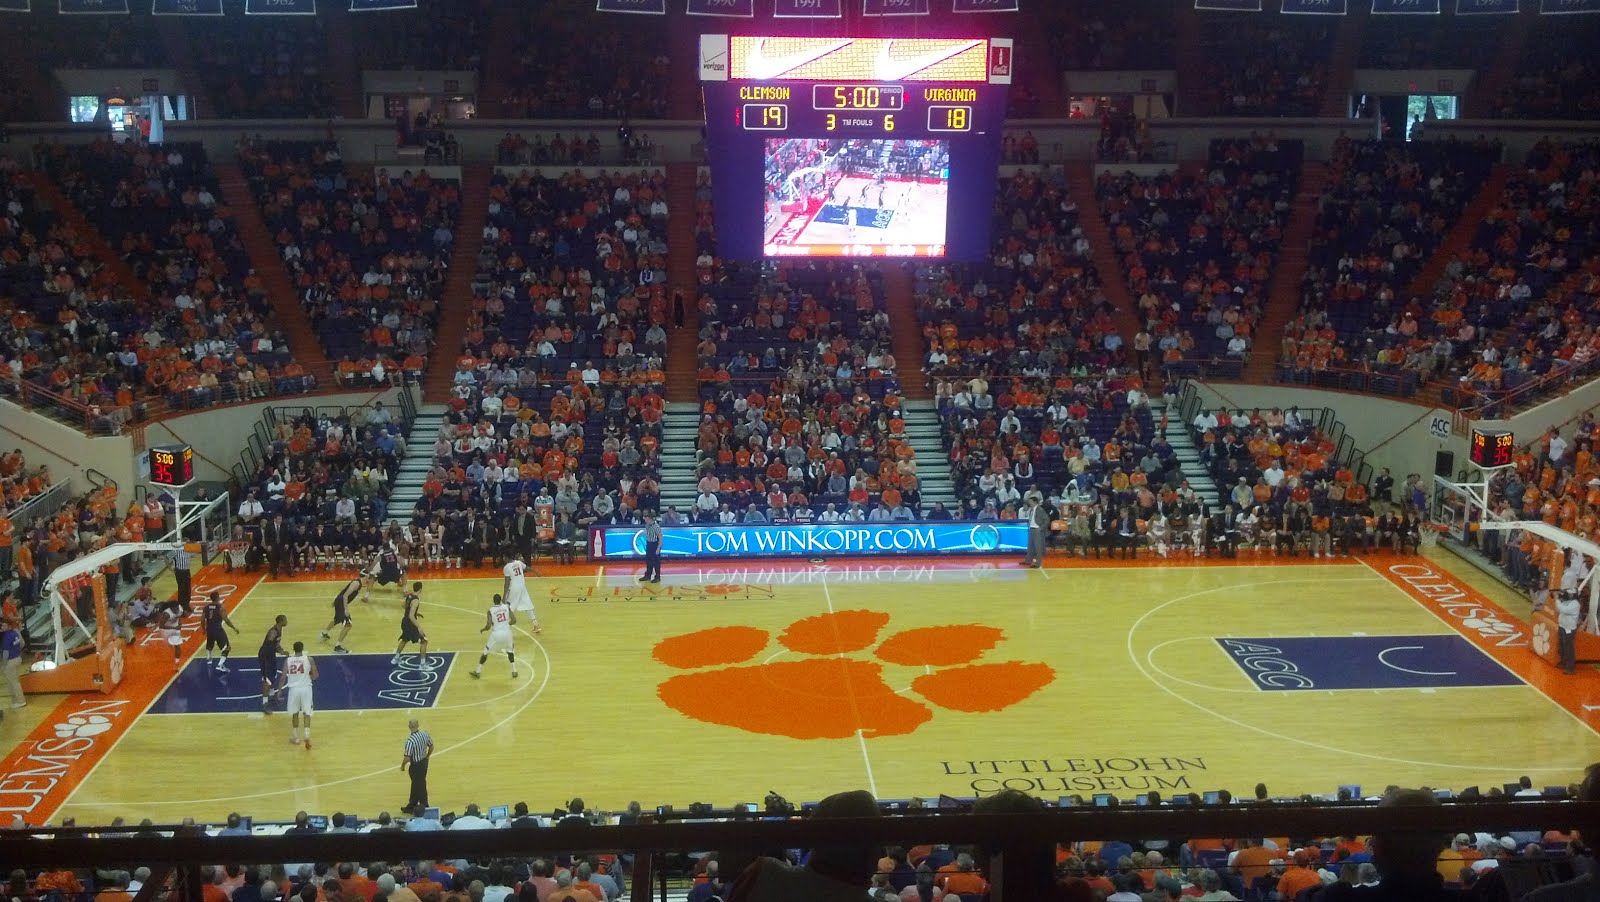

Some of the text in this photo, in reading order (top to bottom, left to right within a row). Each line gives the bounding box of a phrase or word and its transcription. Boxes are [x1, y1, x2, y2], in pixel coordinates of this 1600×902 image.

[703, 62, 725, 70] verizon
[740, 86, 790, 100] CLEMSON
[834, 86, 879, 108] 5:00
[890, 96, 895, 106] 1
[924, 88, 977, 102] VIRGINIA
[763, 106, 781, 126] 19
[826, 113, 836, 131] 3
[884, 114, 895, 131] 6
[947, 108, 966, 129] 18
[1431, 417, 1450, 434] ACC
[1496, 435, 1512, 448] 5:00
[155, 452, 174, 465] 5:00
[1493, 446, 1509, 465] 35
[154, 463, 173, 484] 35
[691, 528, 936, 552] TOM WINKOPP.COM
[513, 567, 521, 577] 31
[1389, 564, 1529, 648] CLEMSON
[496, 612, 507, 623] 21
[289, 663, 304, 675] 24
[1225, 639, 1314, 688] ACC
[377, 654, 445, 706] ACC
[0, 699, 130, 821] LEMSON
[940, 757, 1207, 775] LITTLEJOHN
[970, 775, 1192, 793] COLISEUM
